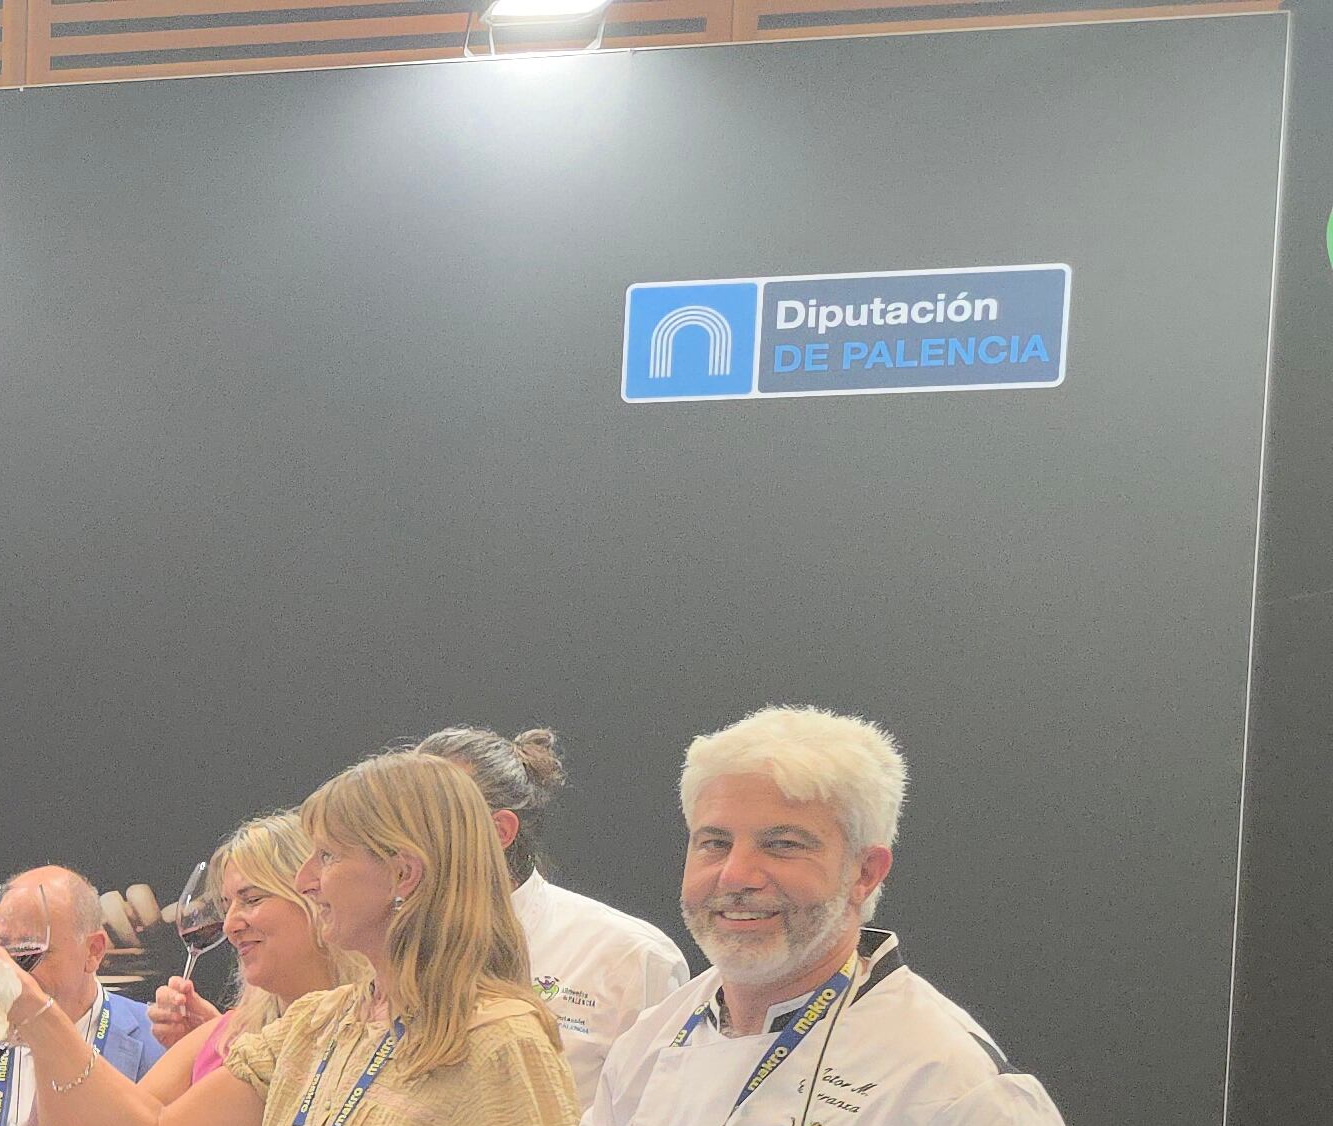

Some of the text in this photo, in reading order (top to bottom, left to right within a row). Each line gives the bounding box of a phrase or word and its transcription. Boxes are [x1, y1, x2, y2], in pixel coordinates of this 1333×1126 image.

[775, 292, 999, 335] Diputación
[773, 334, 1050, 373] DE PALENCIA
[96, 1008, 110, 1040] makro
[792, 987, 837, 1035] makro
[366, 1036, 397, 1077] makro
[748, 1046, 788, 1092] makro
[334, 1086, 364, 1126] makro
